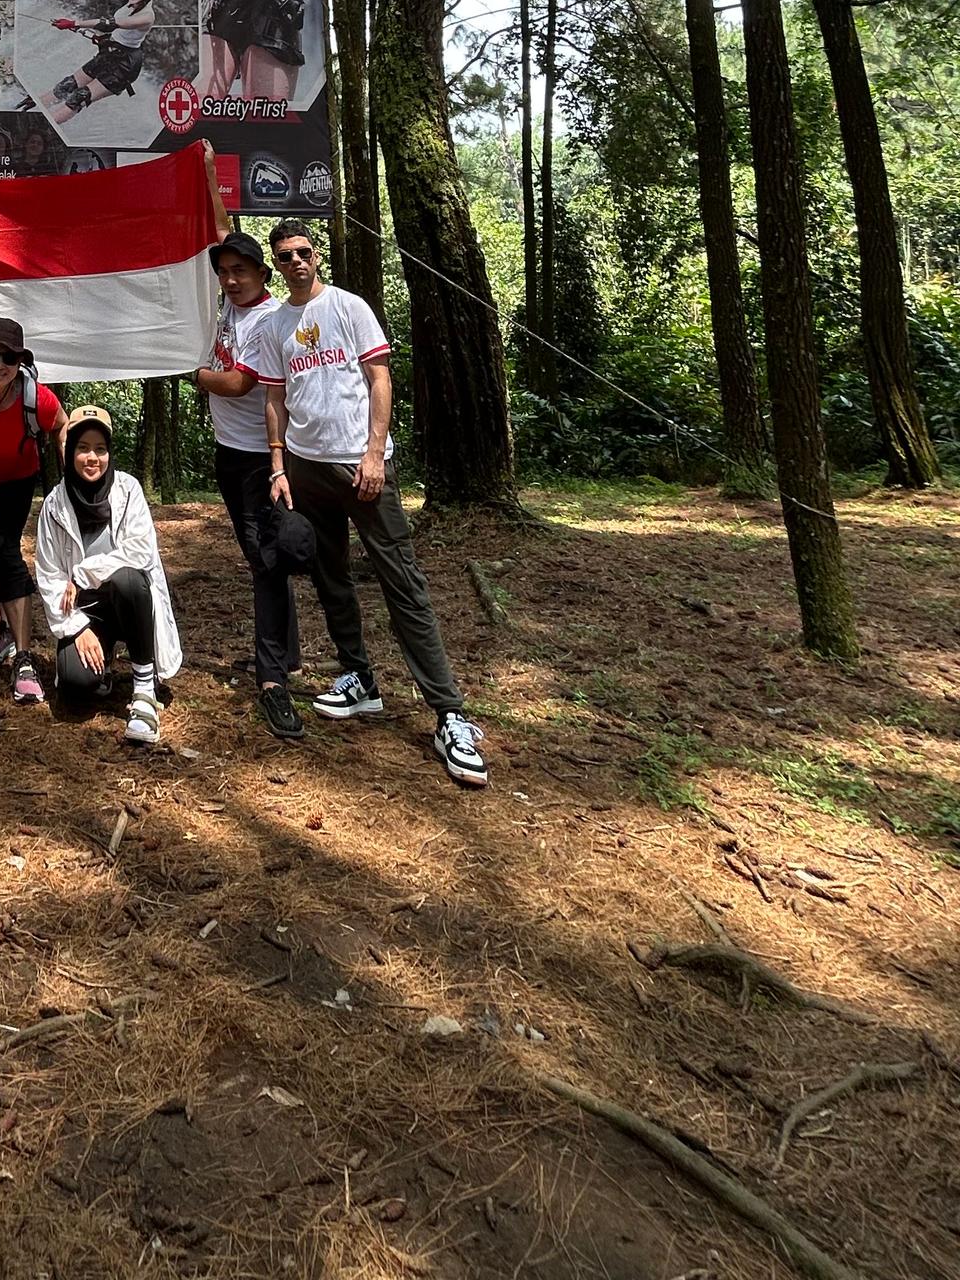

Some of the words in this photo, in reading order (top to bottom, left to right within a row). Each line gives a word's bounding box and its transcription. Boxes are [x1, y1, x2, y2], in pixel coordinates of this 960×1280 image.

[162, 80, 181, 97] SAFETY
[181, 80, 195, 97] FIRST
[202, 97, 250, 121] Safety
[253, 99, 287, 118] First
[162, 115, 182, 132] SAFETY
[181, 116, 195, 132] FIRST
[299, 174, 334, 195] ADVENTUR
[288, 348, 347, 374] NDONESIA
